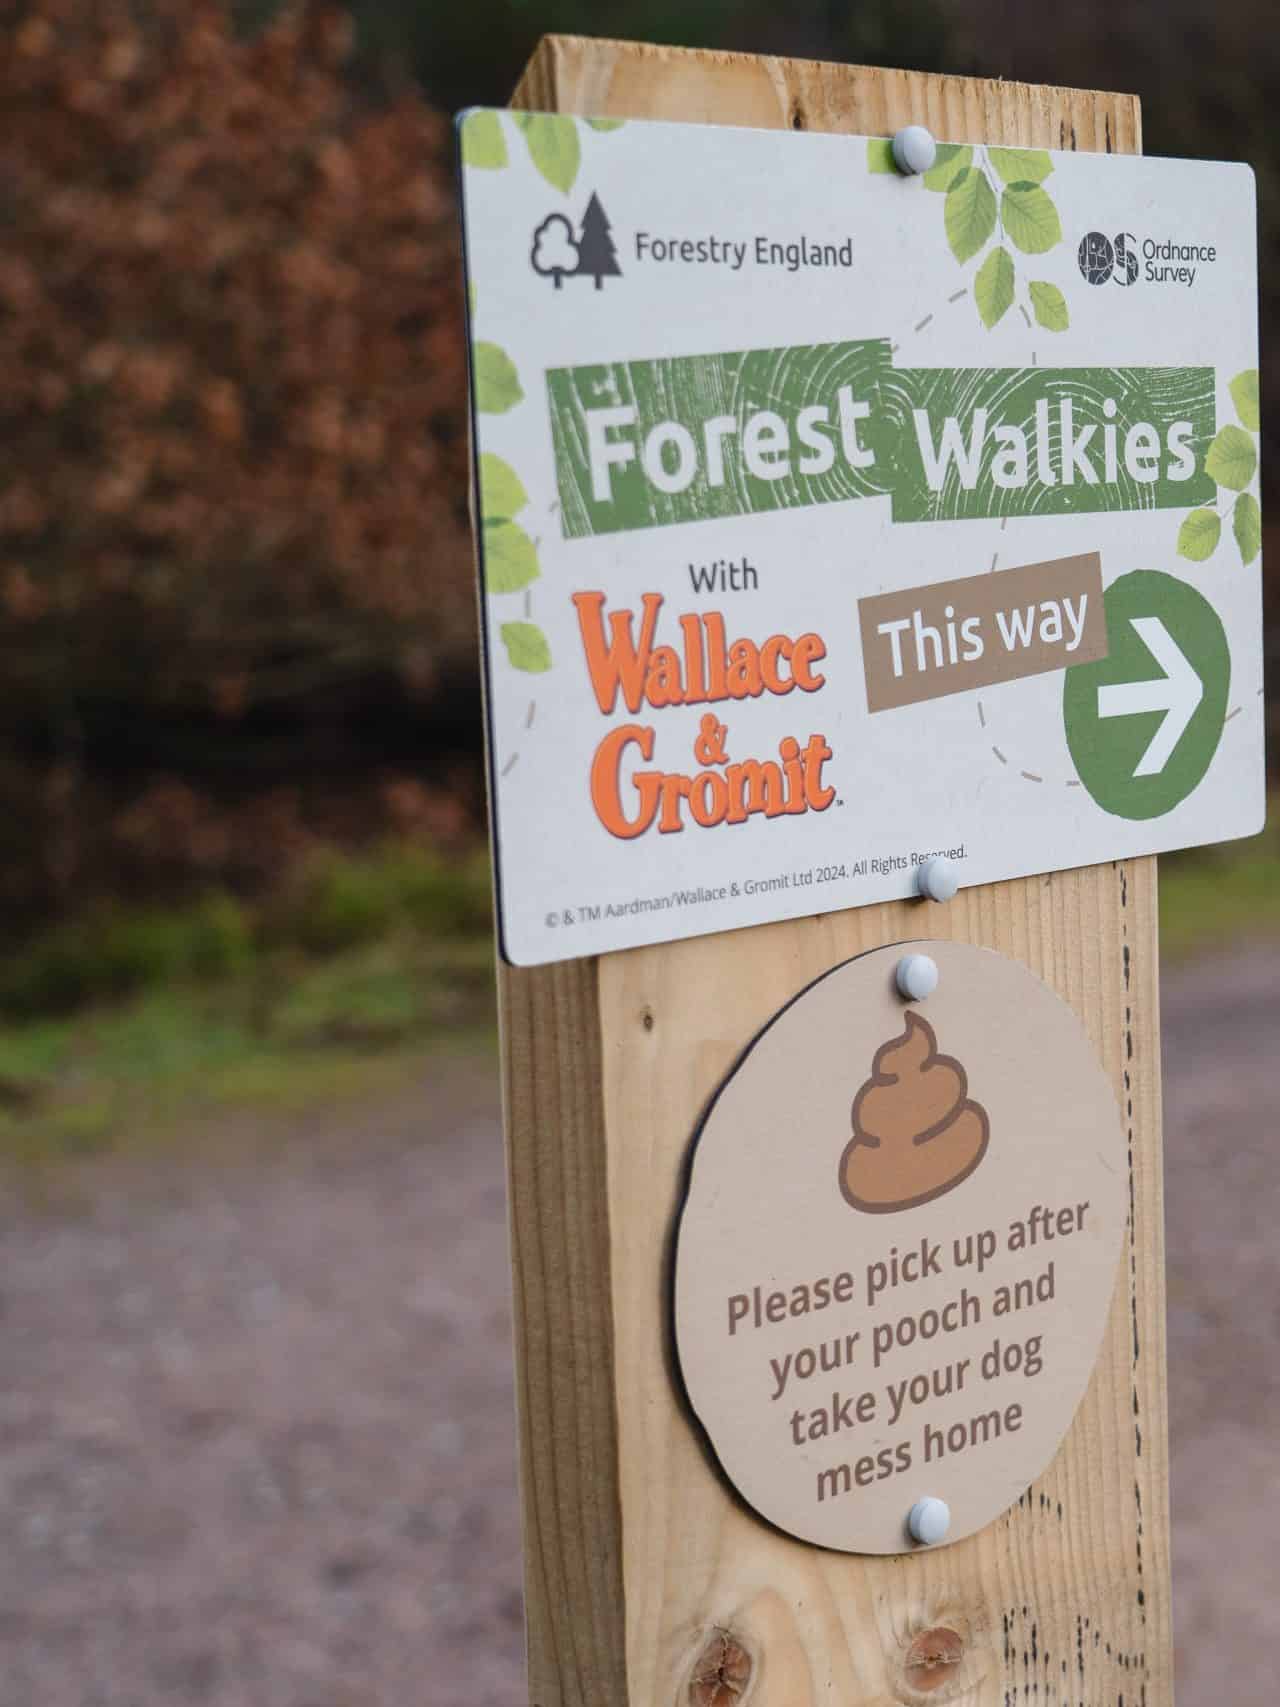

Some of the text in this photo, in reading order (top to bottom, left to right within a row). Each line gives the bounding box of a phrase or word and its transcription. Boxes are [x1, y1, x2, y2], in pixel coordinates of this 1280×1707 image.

[635, 232, 853, 272] Forestry England
[1142, 238, 1217, 262] Ordnance
[1145, 260, 1197, 288] Survey
[586, 384, 1196, 503] Forest Walkies
[688, 556, 759, 594] With
[571, 590, 828, 716] Wallace
[877, 593, 1088, 678] This way
[590, 723, 837, 841] Gromit
[693, 712, 730, 767] &
[564, 908, 575, 925] &
[577, 904, 601, 922] TM
[605, 885, 728, 919] Aardman/Wallace
[730, 881, 741, 897] &
[743, 873, 790, 896] Gromit
[792, 866, 813, 888] Ltd
[815, 863, 850, 884] 2024.
[852, 859, 868, 877] All
[871, 854, 908, 876] Rights
[726, 1200, 1091, 1336] Please pick up after
[768, 1262, 1056, 1400] your pooch and
[789, 1334, 1044, 1446] take your dog
[815, 1402, 1023, 1501] mess home
